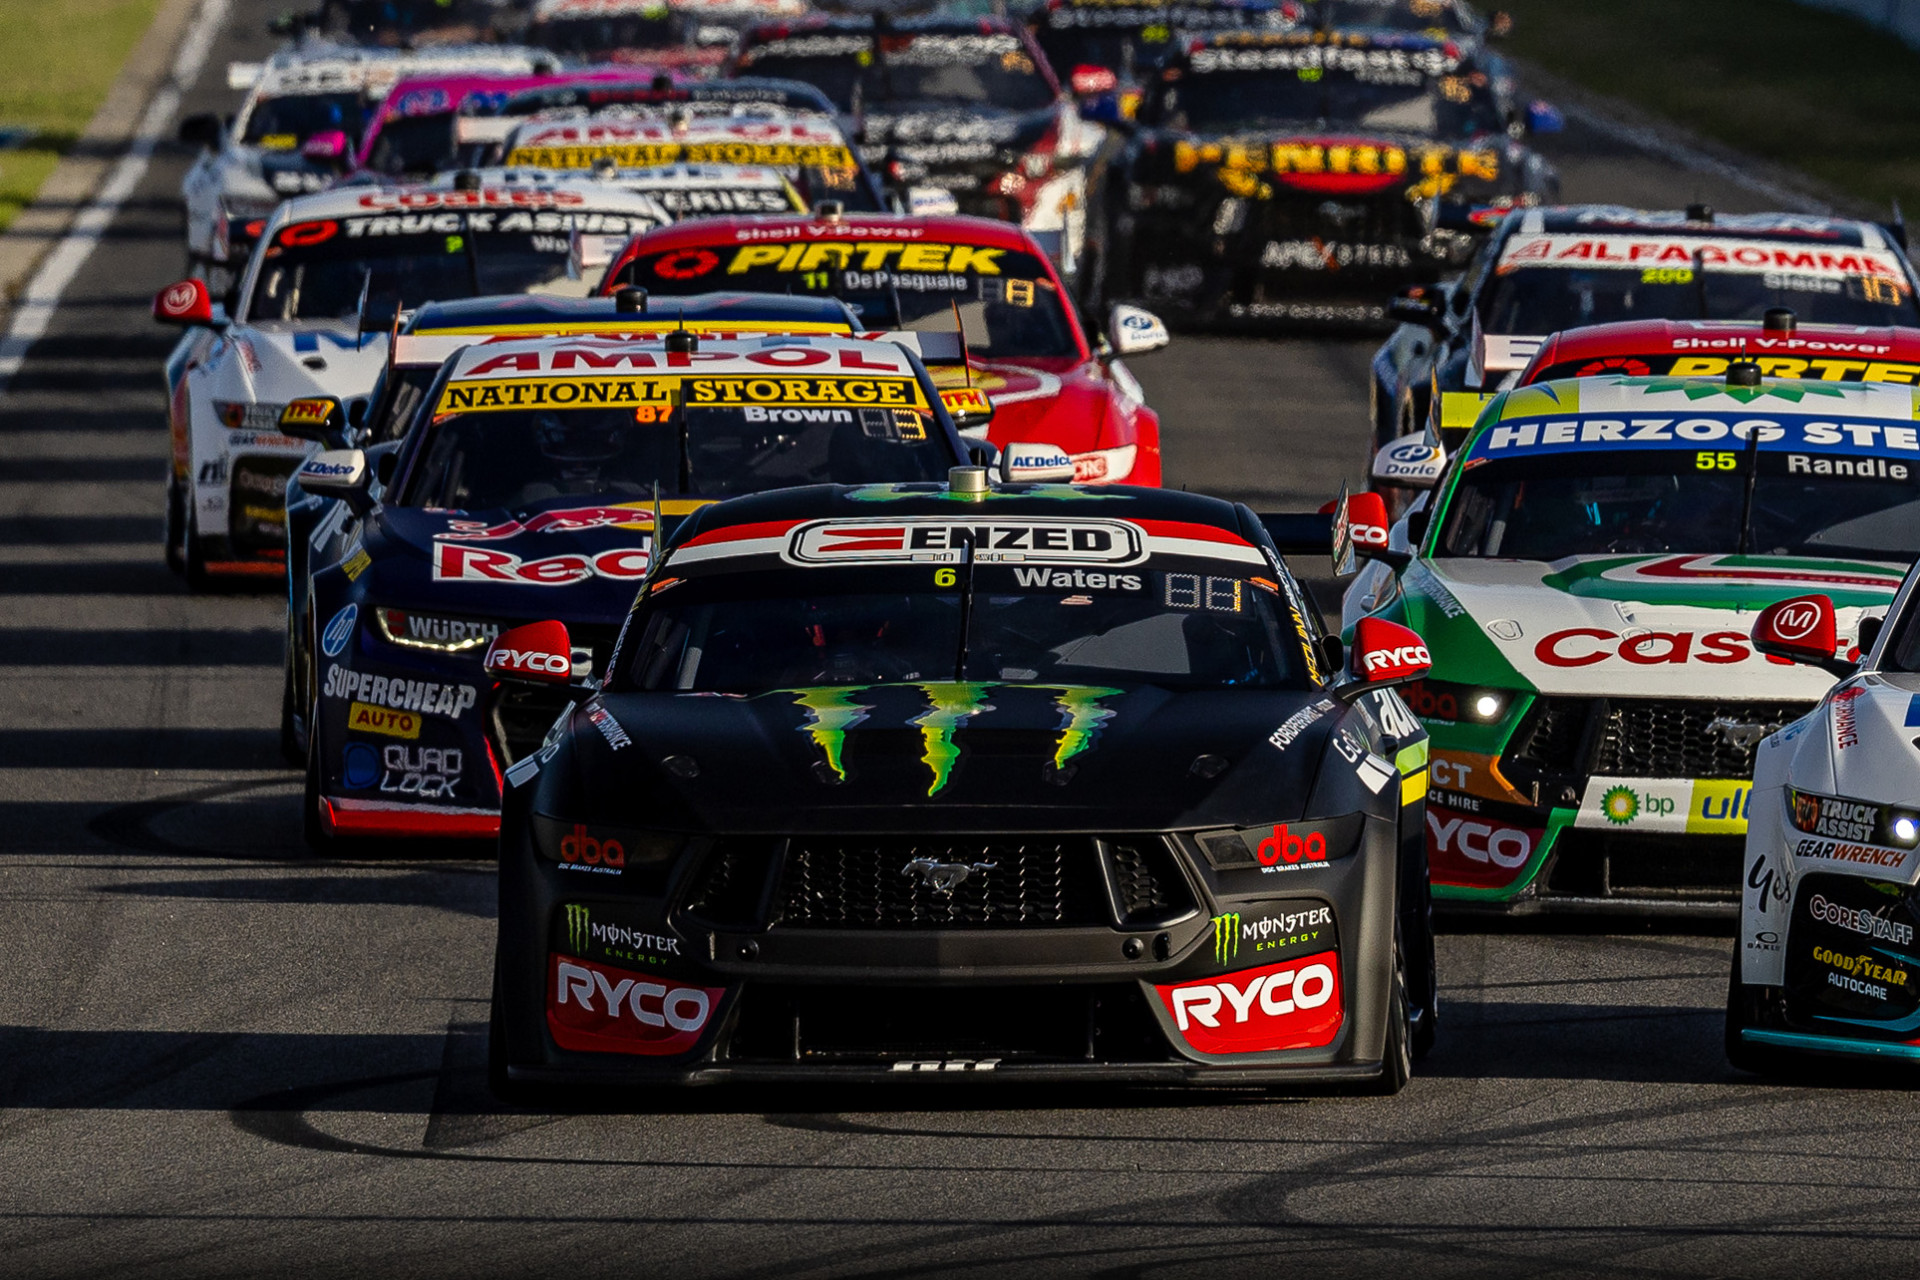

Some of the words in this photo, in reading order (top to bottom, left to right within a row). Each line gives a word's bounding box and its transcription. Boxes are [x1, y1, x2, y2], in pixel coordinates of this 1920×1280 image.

[656, 188, 789, 213] ERIES
[346, 213, 496, 237] TRUCK
[736, 226, 800, 241] Shell
[806, 225, 924, 239] V-Power
[727, 242, 1007, 275] PIRTEK
[802, 272, 829, 289] 11
[1672, 337, 1747, 350] Shell
[1754, 337, 1892, 355] V-Power
[463, 347, 899, 377] AMPOL
[1668, 356, 1920, 385] PRTE
[446, 380, 667, 409] NATIONAL
[692, 379, 906, 403] STORAGE
[635, 405, 674, 424] 87
[743, 405, 853, 423] Brown
[1488, 418, 1786, 450] HERZOG
[1385, 463, 1436, 476] Doric
[1696, 451, 1737, 472] 55
[1786, 454, 1908, 481] Randle
[909, 526, 1112, 552] ENZED
[1349, 523, 1388, 544] CO
[934, 567, 957, 588] 6
[1013, 567, 1142, 591] Waters
[489, 649, 570, 674] RYCO
[1363, 645, 1431, 672] RYCO
[323, 662, 478, 719] SUPERCHEAP
[355, 708, 414, 732] AUTO
[383, 744, 463, 775] QUAD
[1431, 758, 1472, 789] CT
[379, 769, 462, 798] LOCK
[1448, 794, 1480, 812] HIRE
[1645, 791, 1675, 819] bp
[1820, 800, 1878, 824] TRUCK
[1426, 809, 1531, 869] YCO
[1815, 817, 1875, 842] ASSIST
[560, 823, 625, 868] dba
[1257, 823, 1327, 867] dba
[1795, 839, 1908, 868] GEARWRENCH
[591, 921, 681, 956] MONSTER
[1242, 906, 1332, 942] MONSTER
[1255, 931, 1320, 952] ENERGY
[604, 947, 669, 966] ENERGY
[1812, 945, 1908, 986] GOODYEAR
[557, 962, 710, 1032] RYCO
[1171, 961, 1335, 1032] RYCO
[1827, 971, 1888, 1001] AUTOCARE
